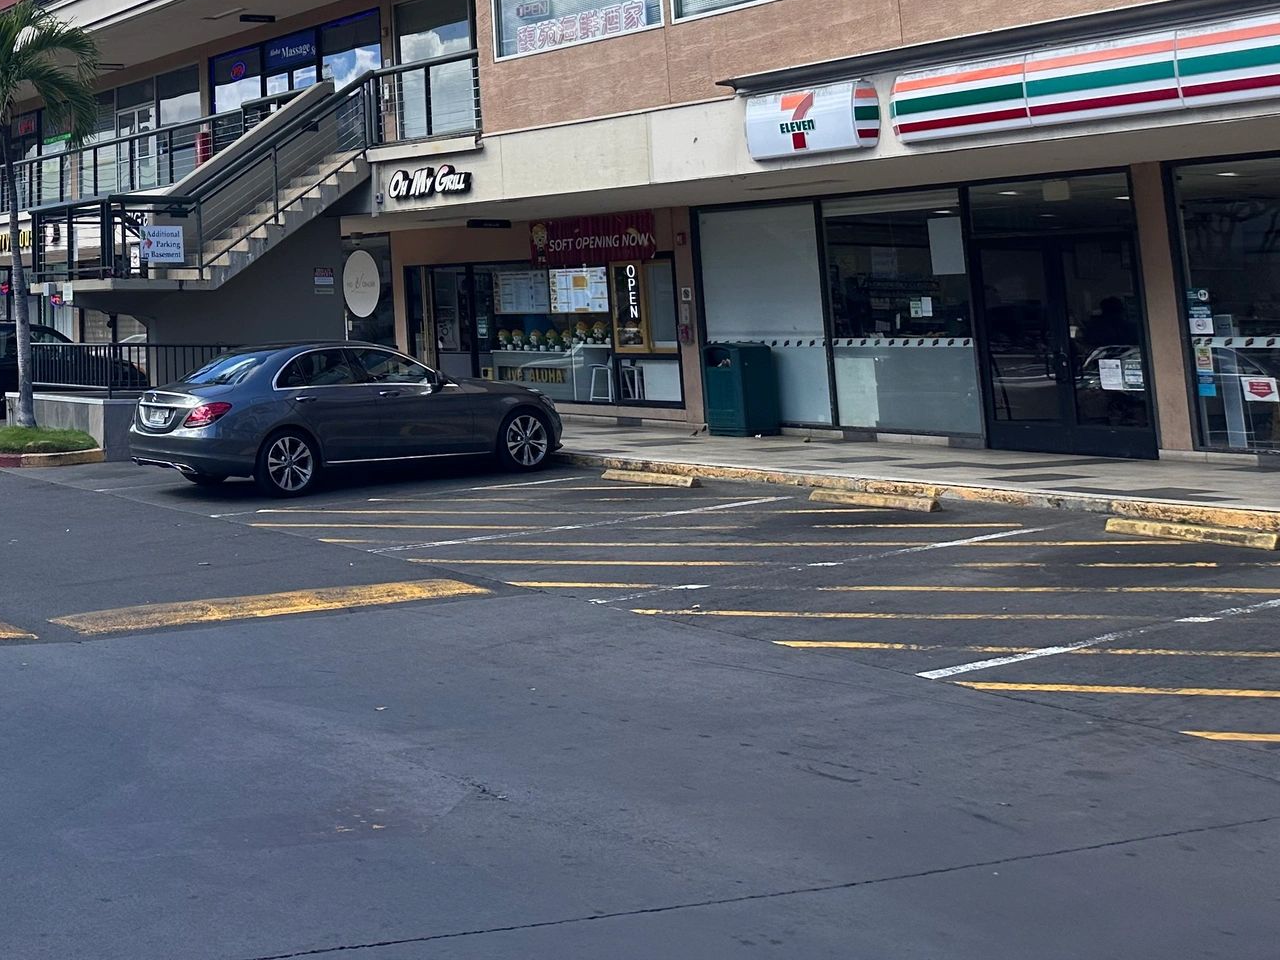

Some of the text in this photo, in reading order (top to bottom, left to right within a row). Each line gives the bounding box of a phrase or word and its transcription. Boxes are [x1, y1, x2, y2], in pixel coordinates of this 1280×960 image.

[281, 43, 310, 59] Massage
[147, 230, 180, 238] Additional
[548, 232, 649, 252] SOFT OPENING NOW
[156, 241, 181, 249] Parking
[626, 264, 639, 319] OPEN
[529, 368, 564, 384] ALOHA
